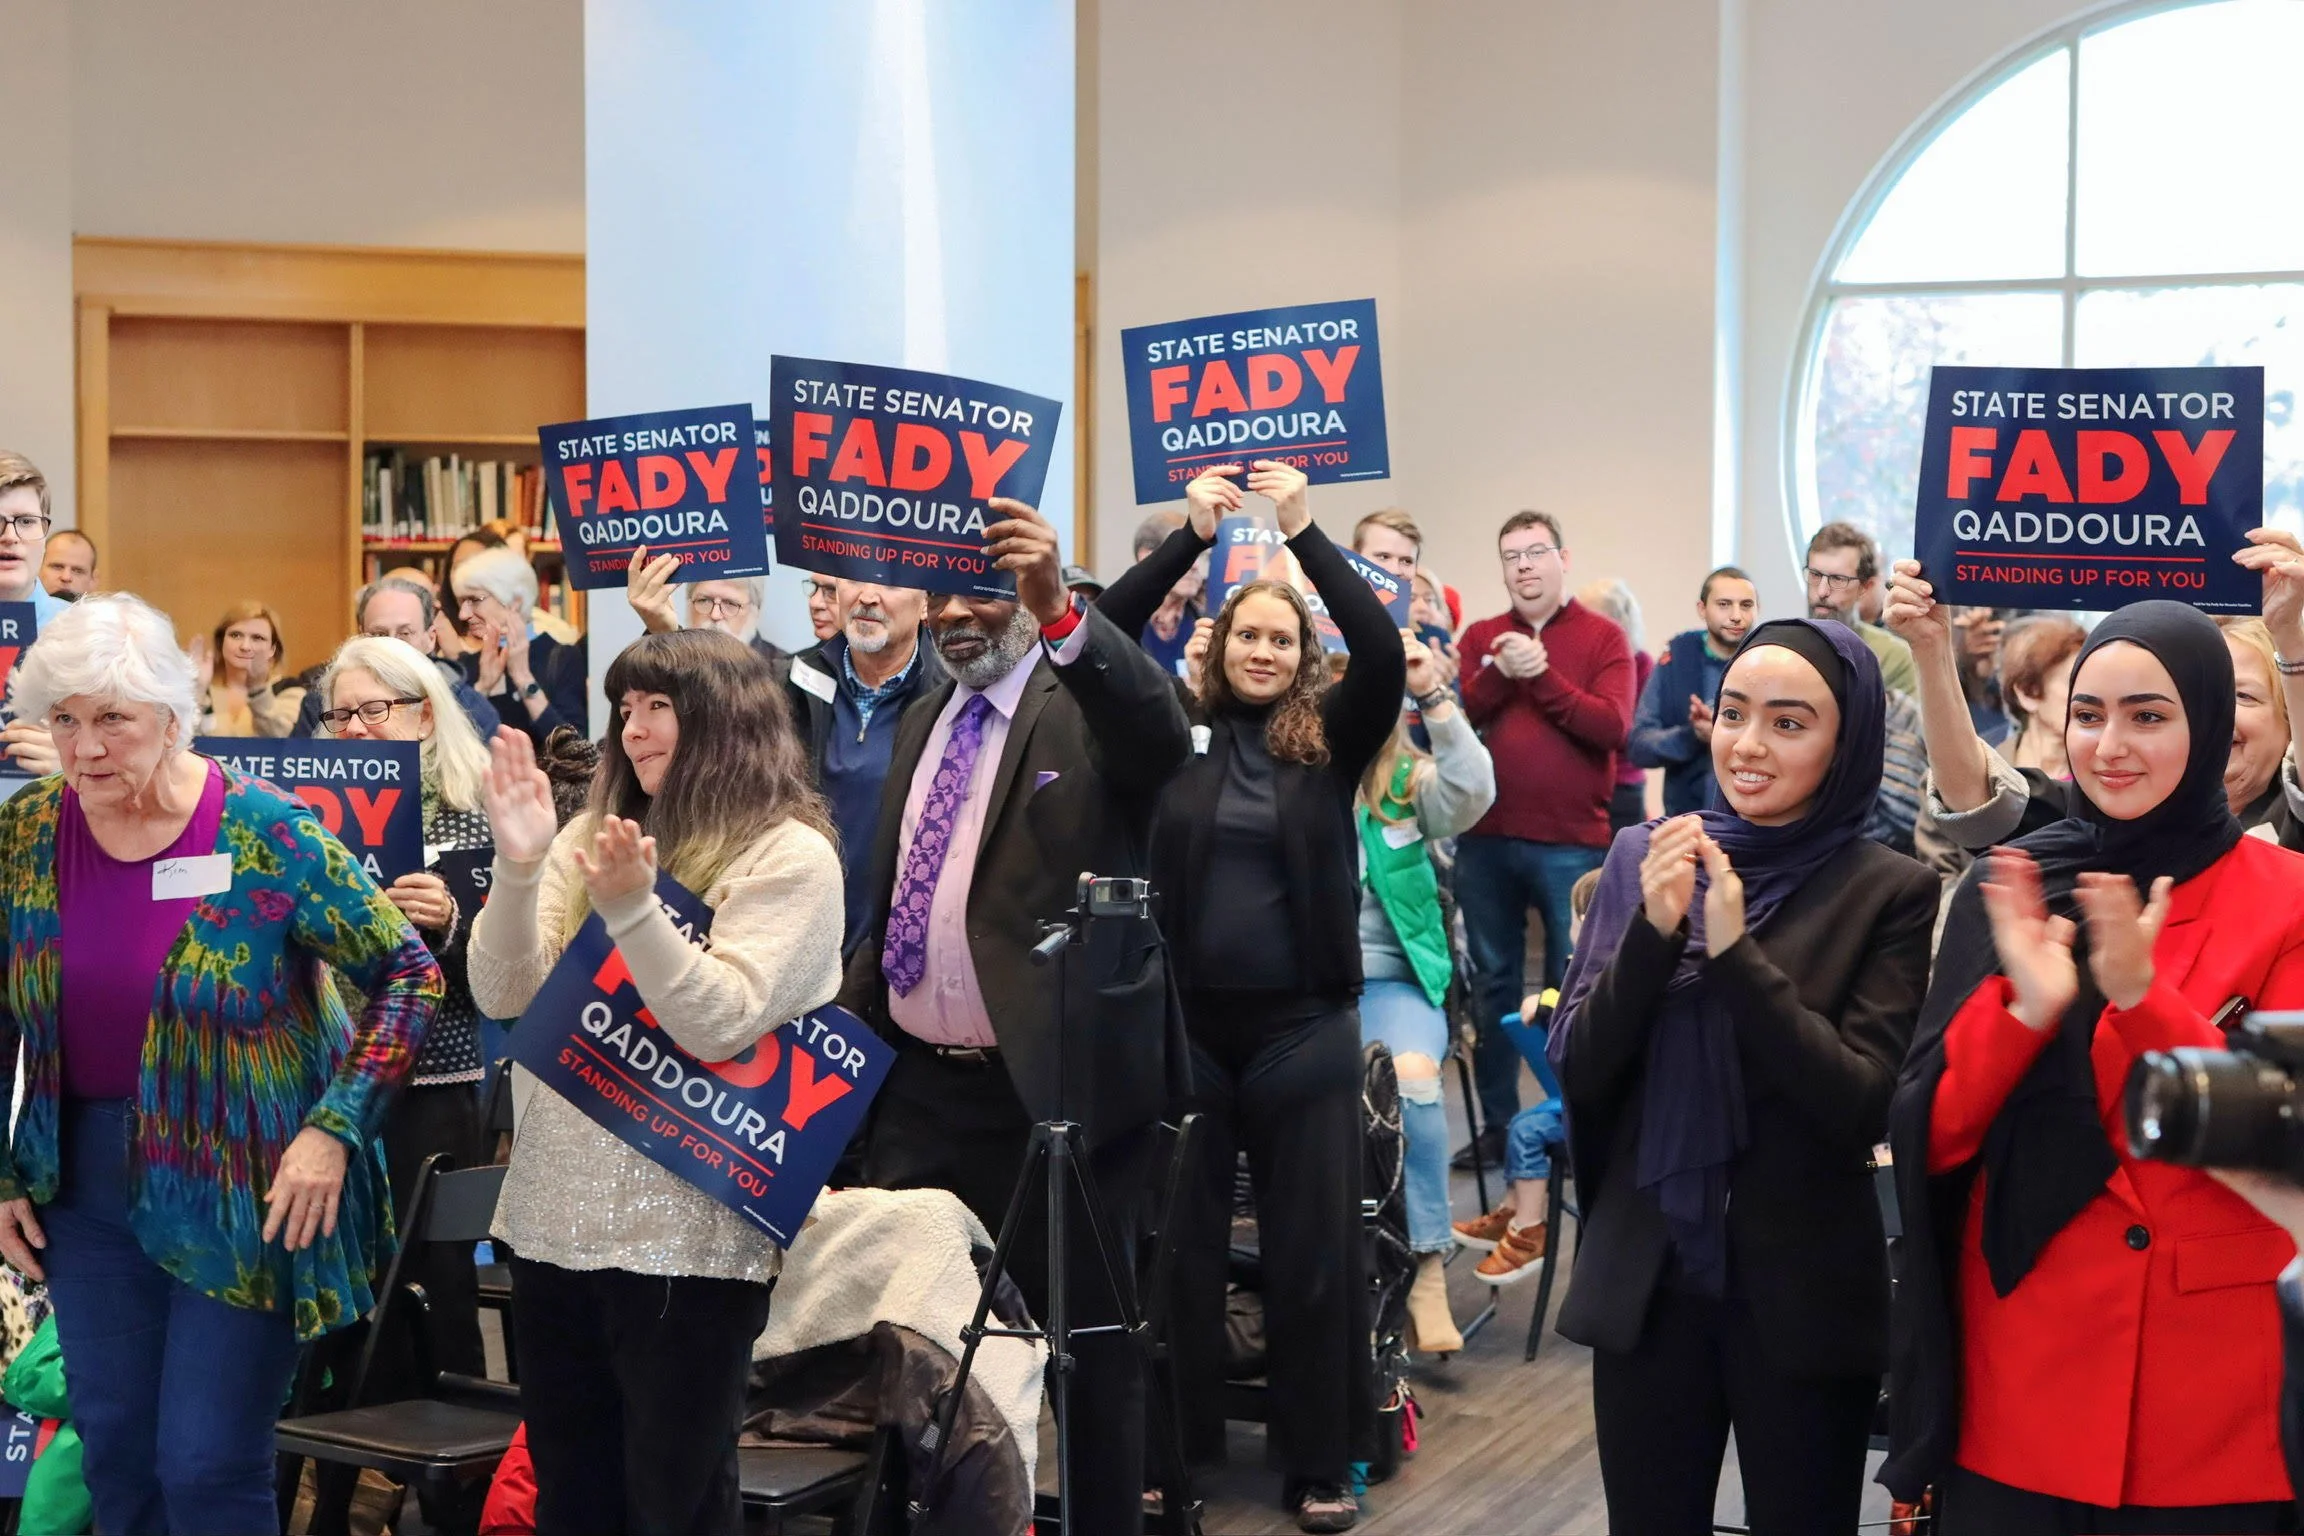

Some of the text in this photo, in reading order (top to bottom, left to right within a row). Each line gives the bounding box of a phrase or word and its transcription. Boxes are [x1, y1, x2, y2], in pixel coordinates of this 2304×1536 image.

[1147, 318, 1359, 363] STATE SENATOR
[1150, 345, 1361, 423] FADY
[1951, 390, 2235, 420] STATE SENATOR
[793, 379, 1033, 437] STATE SENATOR
[558, 434, 618, 460] STATE
[623, 421, 738, 452] SENATOR
[1161, 409, 1347, 452] QADDOURA
[792, 411, 1031, 500] FADY
[1168, 460, 1245, 482] STANG
[1313, 451, 1349, 466] YOU
[1946, 425, 2237, 505] FADY
[562, 447, 740, 518] FADY
[578, 509, 730, 546] QADDOURA
[798, 485, 987, 535] QADDOURA
[1953, 509, 2206, 547] QADDOURA
[801, 534, 986, 574] STANDING UP FOR YOU
[1231, 527, 1289, 545] STAT
[589, 557, 630, 573] STANDIN
[673, 552, 695, 565] OR
[698, 549, 731, 563] YOU
[1956, 565, 2206, 589] STANDING UP FOR YOU
[282, 757, 401, 781] SENATOR
[294, 786, 402, 847] DY
[581, 1001, 787, 1165] QADDOURA
[557, 1048, 769, 1198] STANDING UP FOR YOU
[5, 1410, 34, 1462] STA
